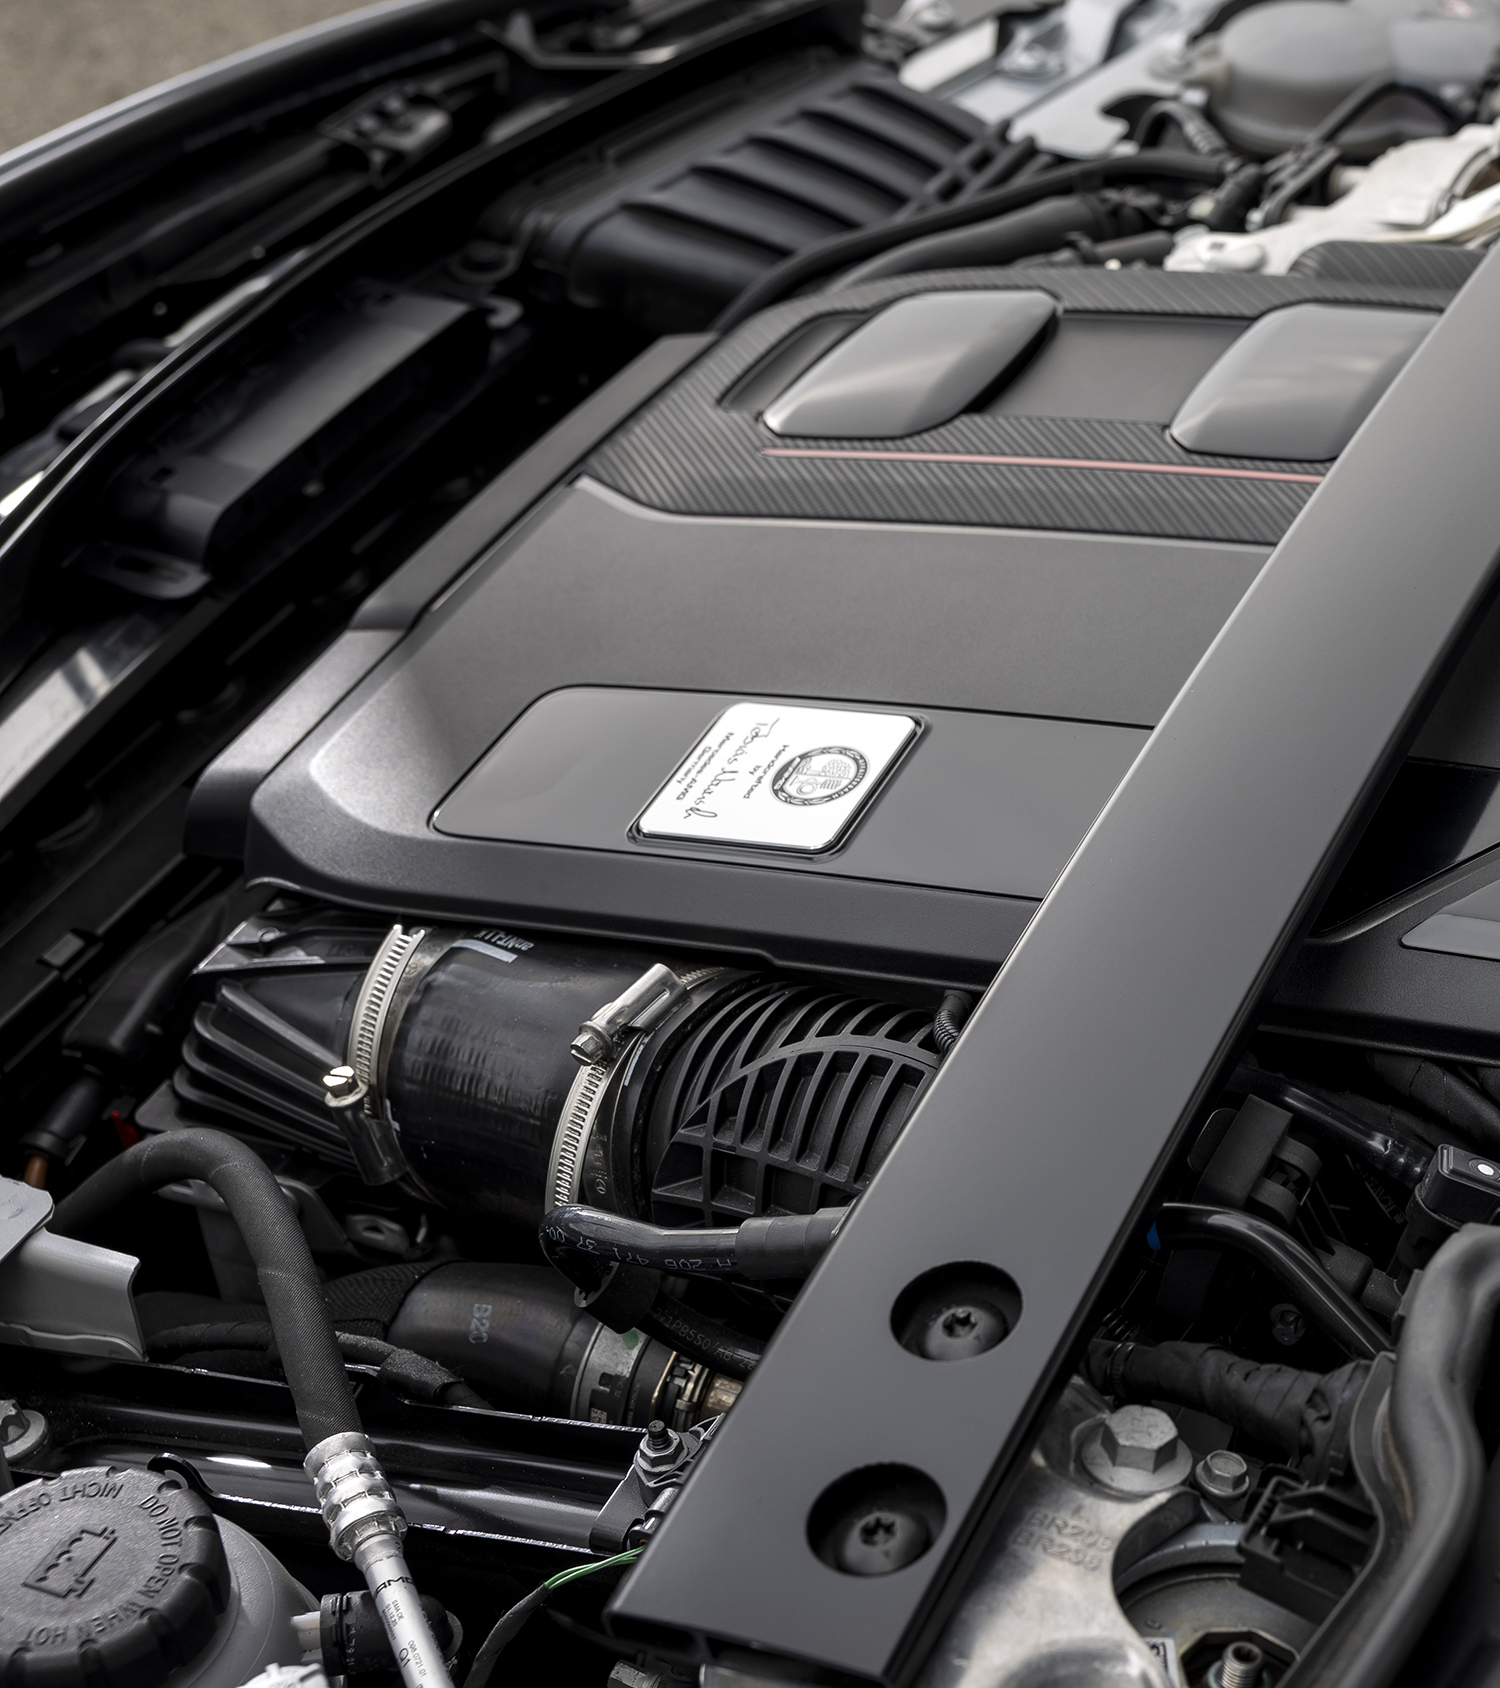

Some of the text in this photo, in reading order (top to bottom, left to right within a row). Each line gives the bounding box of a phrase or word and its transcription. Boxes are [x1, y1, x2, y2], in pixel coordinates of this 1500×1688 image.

[676, 746, 712, 785] Germany
[676, 732, 735, 801] Mercedes-AMG
[743, 744, 790, 799] Handcrafted
[749, 765, 763, 776] by
[576, 1235, 601, 1255] 37
[613, 1247, 649, 1265] 471
[664, 1258, 704, 1271] 206
[469, 1303, 494, 1345] B20
[58, 1482, 124, 1502] NICHT
[17, 1494, 183, 1646] DO NOT OPEN WHEN HOT
[399, 1647, 411, 1668] Q1
